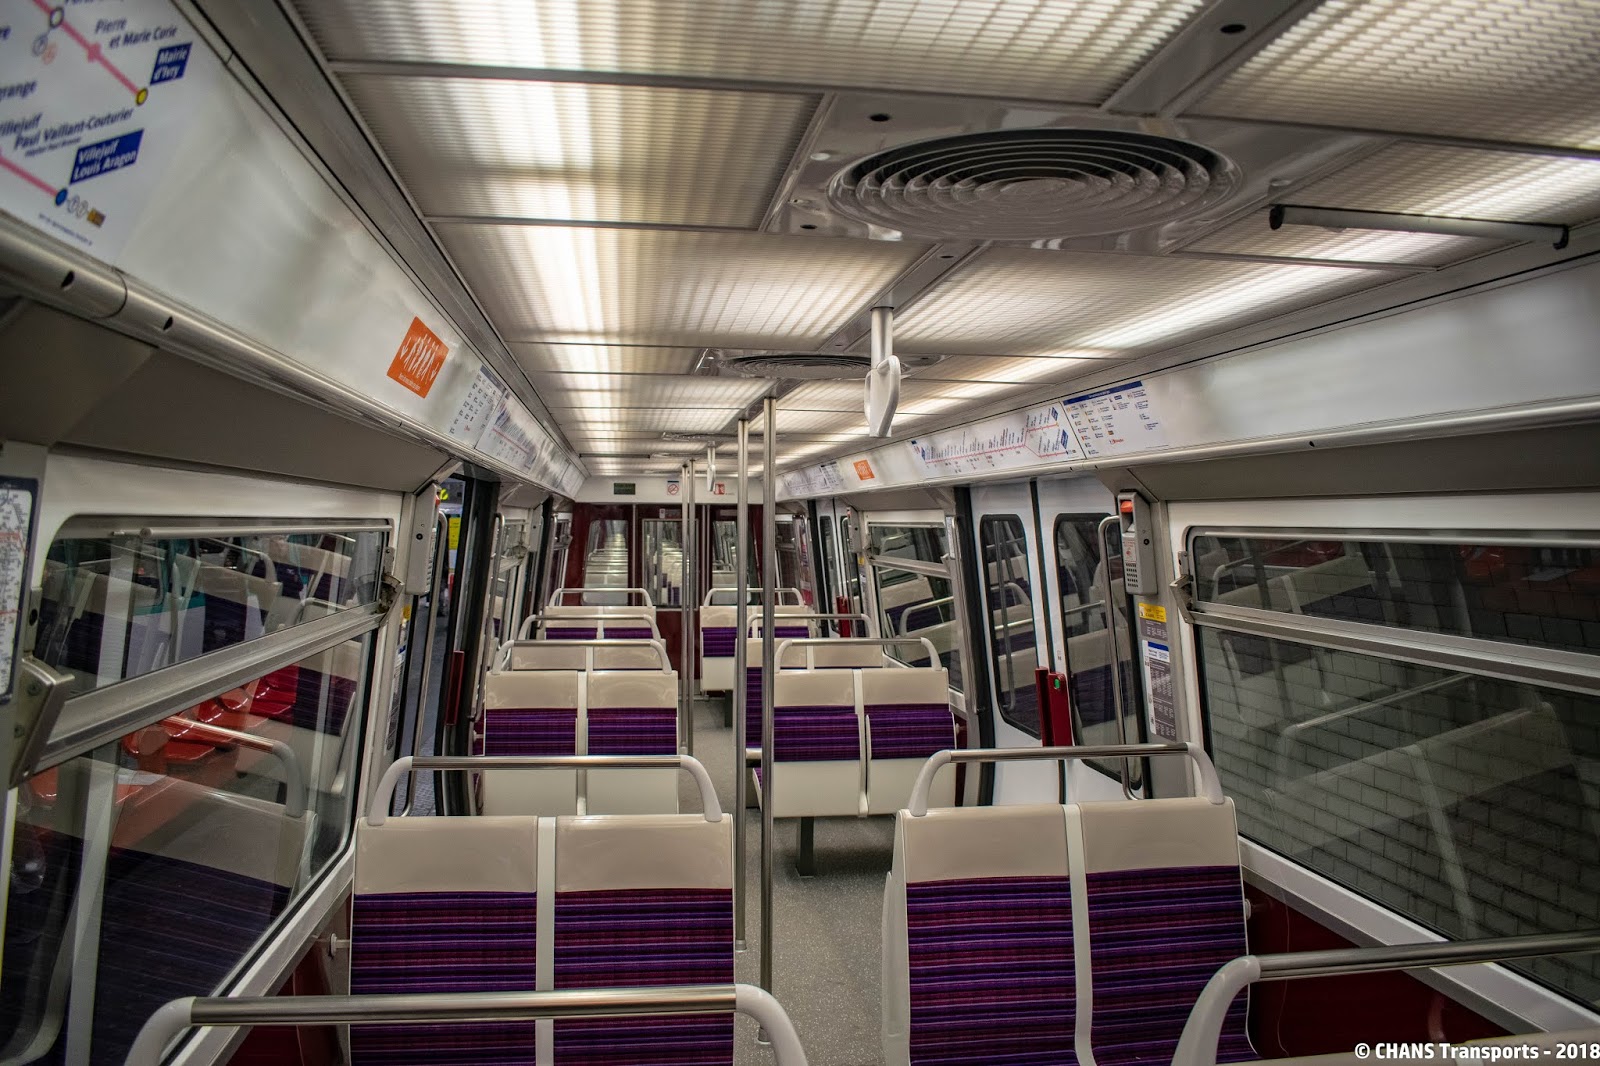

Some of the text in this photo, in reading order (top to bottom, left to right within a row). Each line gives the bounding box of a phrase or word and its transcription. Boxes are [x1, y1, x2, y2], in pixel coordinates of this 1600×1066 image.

[95, 18, 127, 34] Pierre
[109, 25, 177, 49] et Marie Curie
[158, 48, 187, 65] Mairie
[153, 65, 180, 81] d'Ivry
[14, 131, 40, 150] Paul
[44, 107, 135, 141] Vaillant-Couturier
[73, 149, 137, 180] Louis Aragon
